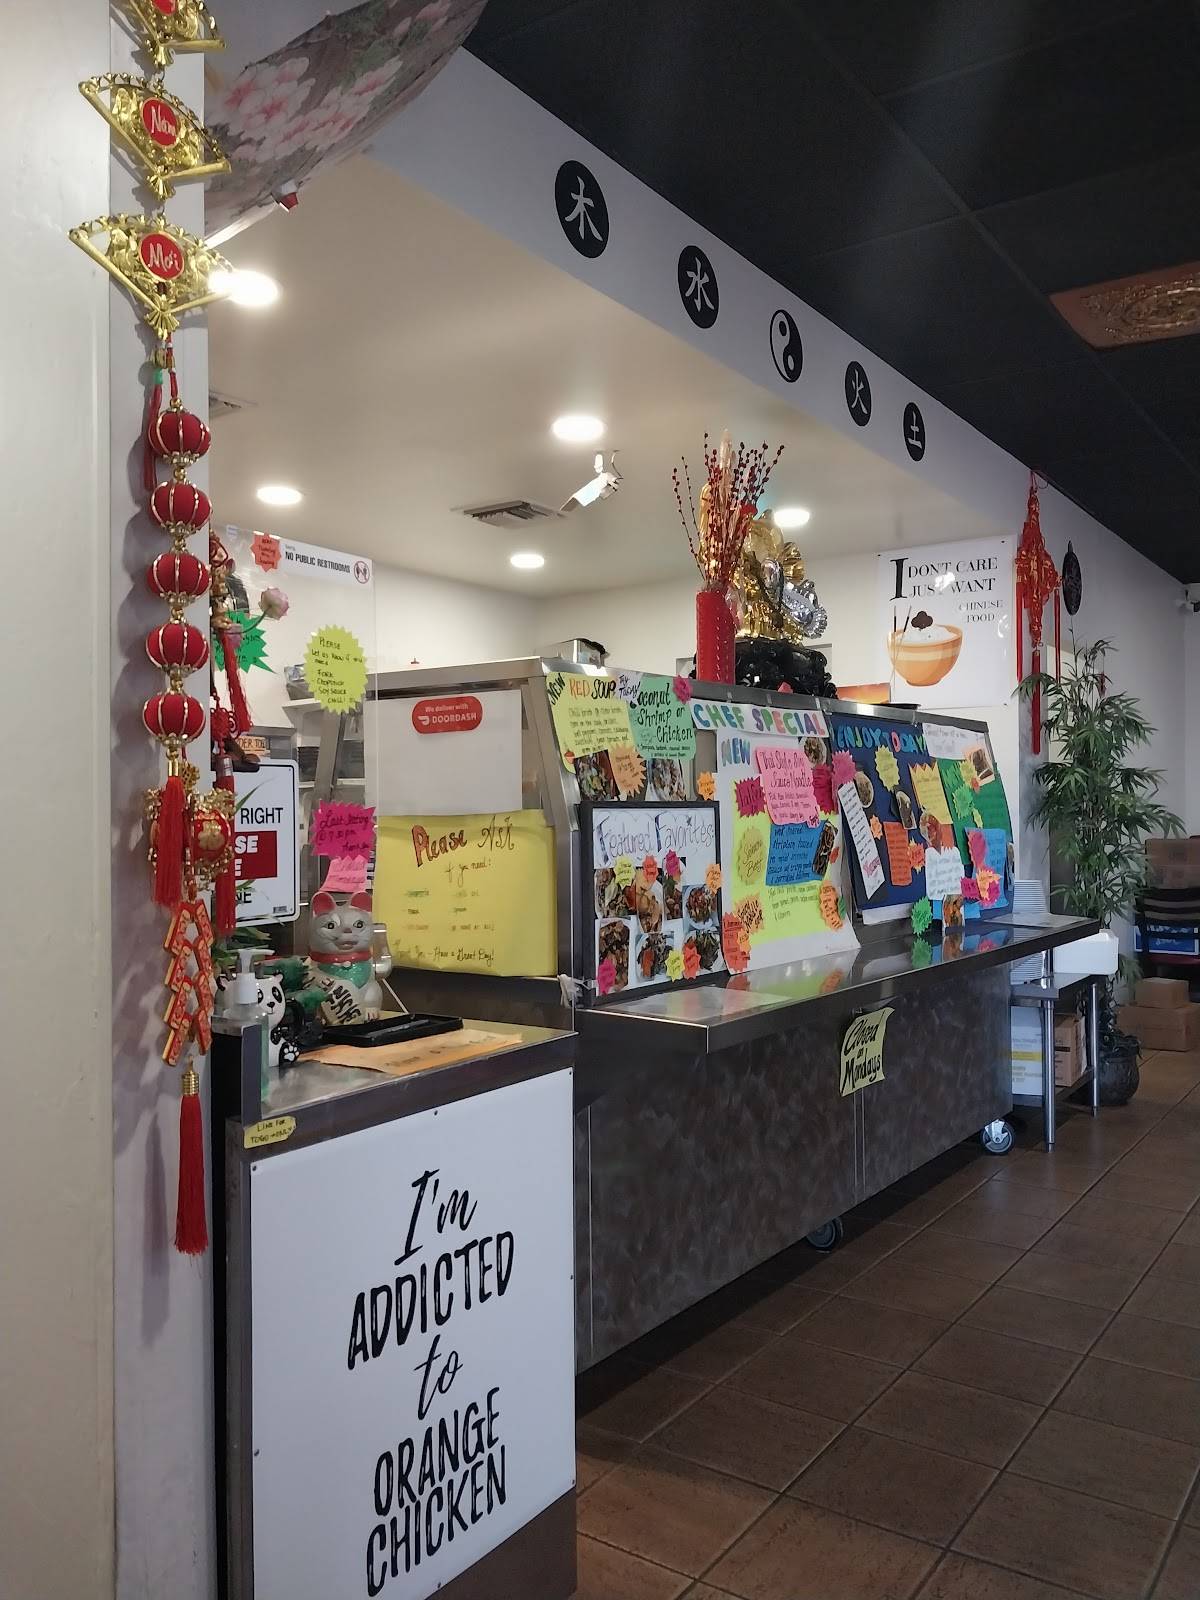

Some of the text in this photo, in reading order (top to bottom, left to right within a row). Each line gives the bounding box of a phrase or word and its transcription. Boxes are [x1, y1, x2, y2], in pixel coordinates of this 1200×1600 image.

[565, 175, 603, 242] 木
[686, 257, 714, 312] 水
[851, 370, 867, 415] 火
[907, 412, 922, 447] 土
[285, 551, 293, 560] NO
[295, 553, 316, 566] PUBLIC
[317, 558, 351, 573] RESTROOMS
[889, 557, 909, 601] I
[956, 557, 998, 573] CARE
[909, 577, 996, 598] JUS WANT
[967, 613, 995, 623] FOOD
[570, 679, 591, 699] RED
[432, 712, 477, 724] DOORDASH
[656, 724, 693, 743] Chicken
[676, 706, 686, 718] or
[694, 703, 826, 736] CHEF SPECIAL
[721, 737, 751, 767] NEW
[837, 725, 882, 749] ENJOY
[241, 807, 284, 825] RIGHT
[411, 824, 467, 868] Please
[594, 815, 652, 865] Featured
[844, 1010, 885, 1056] Closed
[841, 1048, 881, 1095] Mondays
[394, 1168, 479, 1266] I'm
[347, 1230, 515, 1371] ADDICTED
[413, 1333, 463, 1421] to
[373, 1386, 501, 1517] ORANGE
[366, 1444, 507, 1598] CHICKEN
